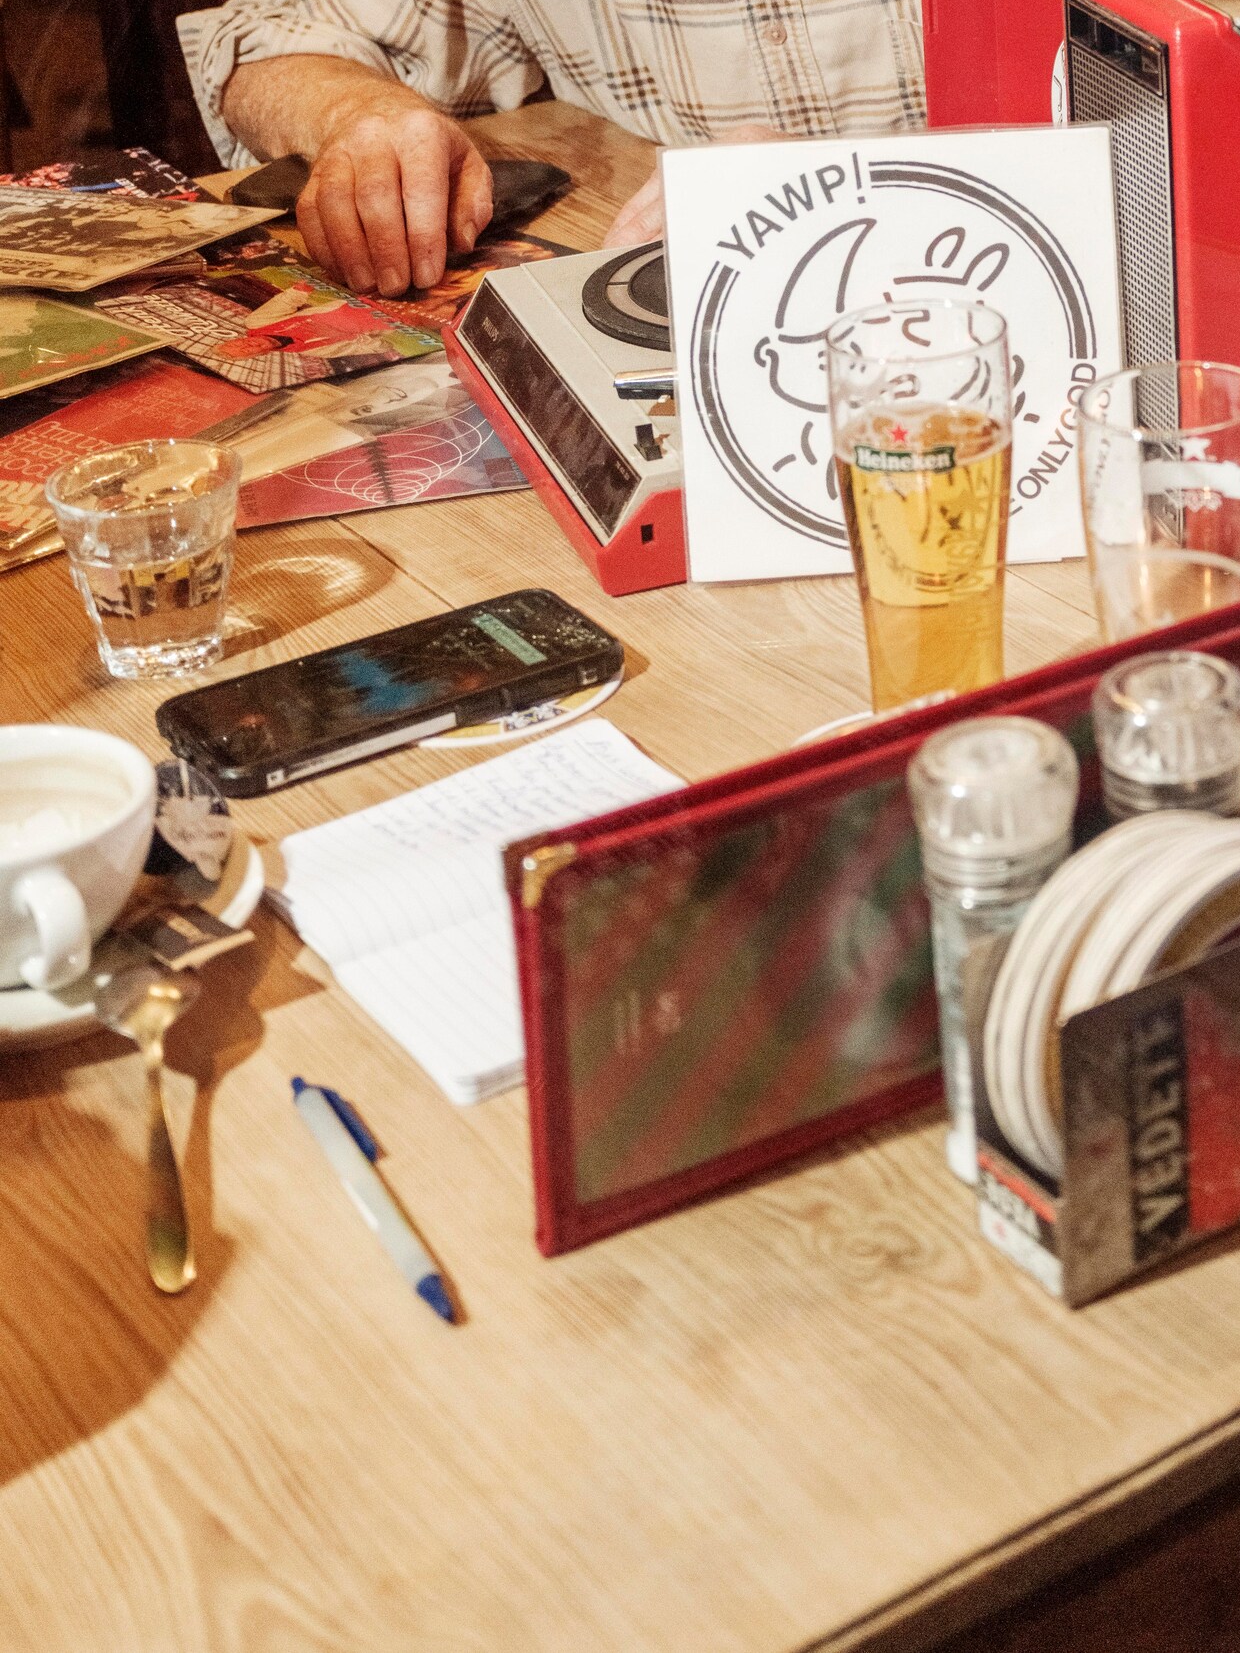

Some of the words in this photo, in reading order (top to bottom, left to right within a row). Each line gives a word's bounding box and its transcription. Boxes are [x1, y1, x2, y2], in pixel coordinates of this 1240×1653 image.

[716, 151, 866, 260] YAWP!
[857, 447, 951, 472] Heineken
[1016, 427, 1074, 500] ONLY
[1059, 362, 1097, 431] GOD
